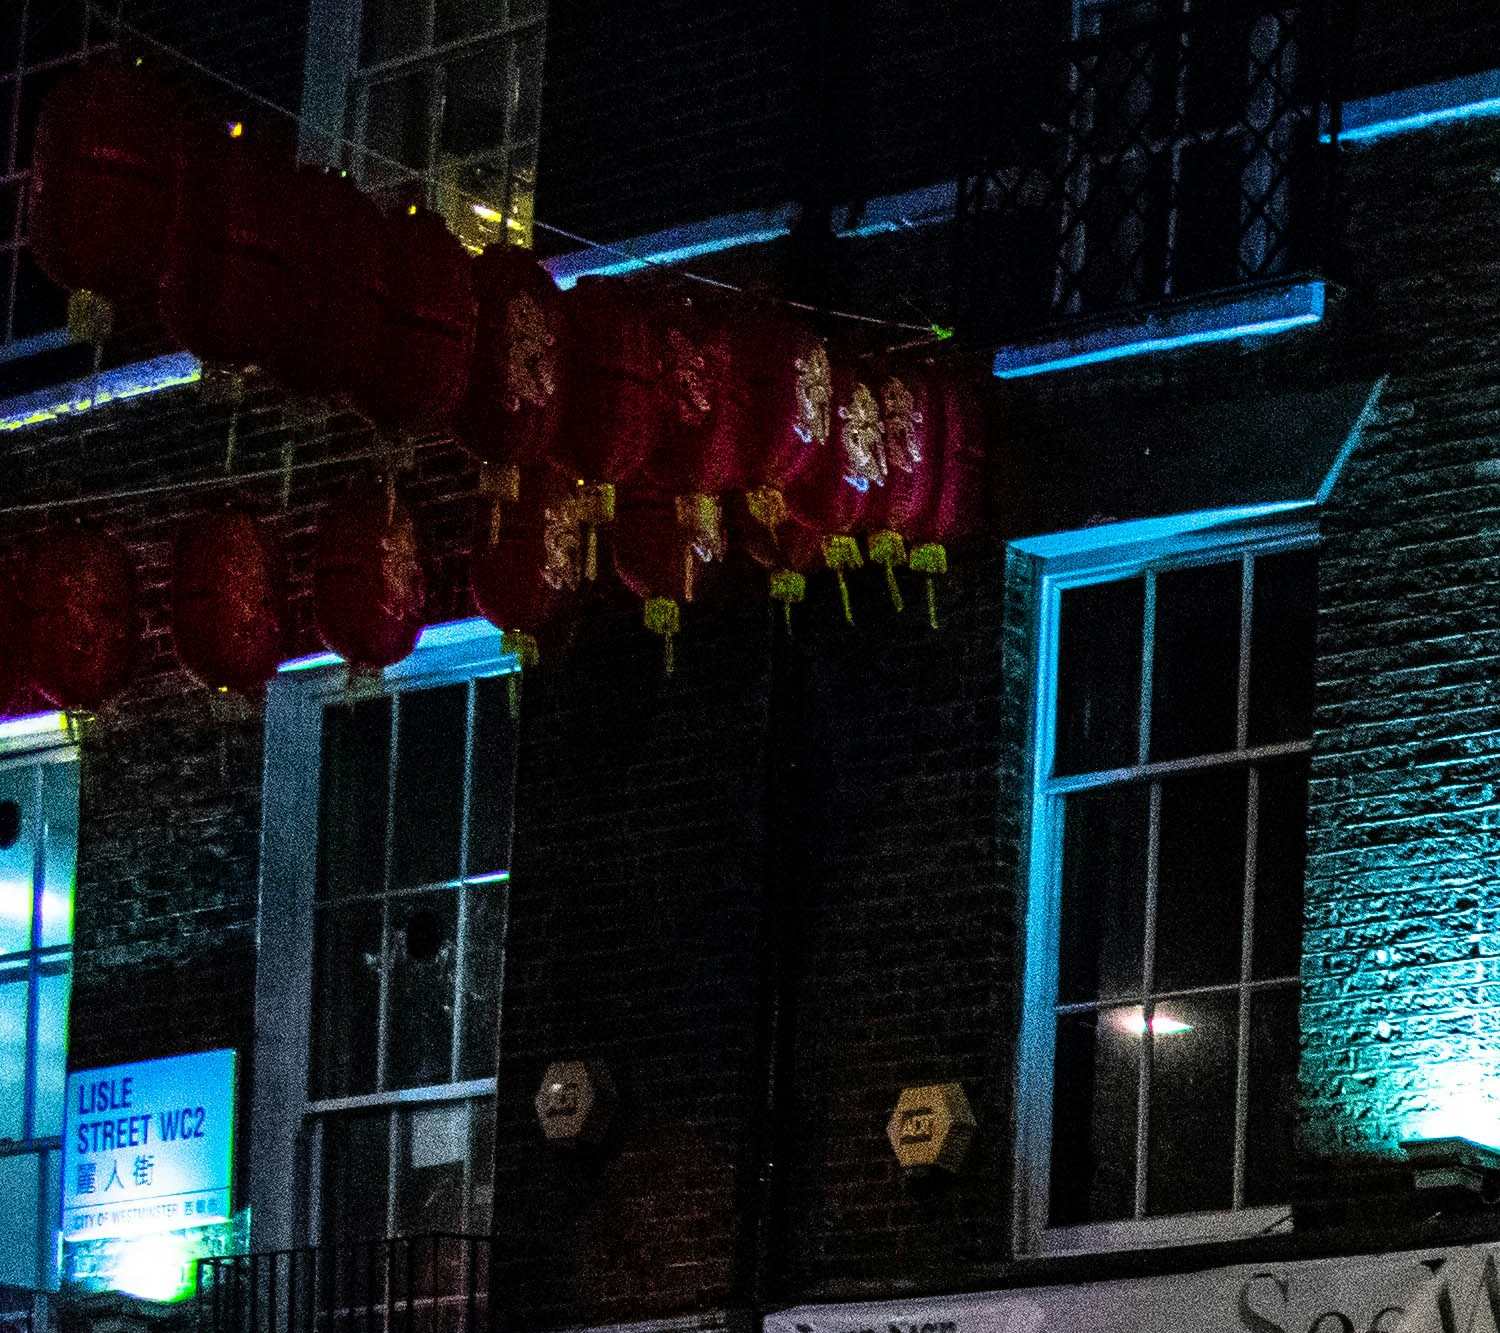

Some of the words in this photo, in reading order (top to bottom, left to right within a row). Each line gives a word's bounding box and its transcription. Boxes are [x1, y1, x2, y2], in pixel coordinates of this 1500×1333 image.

[78, 1076, 135, 1115] LISLE
[77, 1113, 153, 1155] STREET
[160, 1105, 206, 1142] WC2
